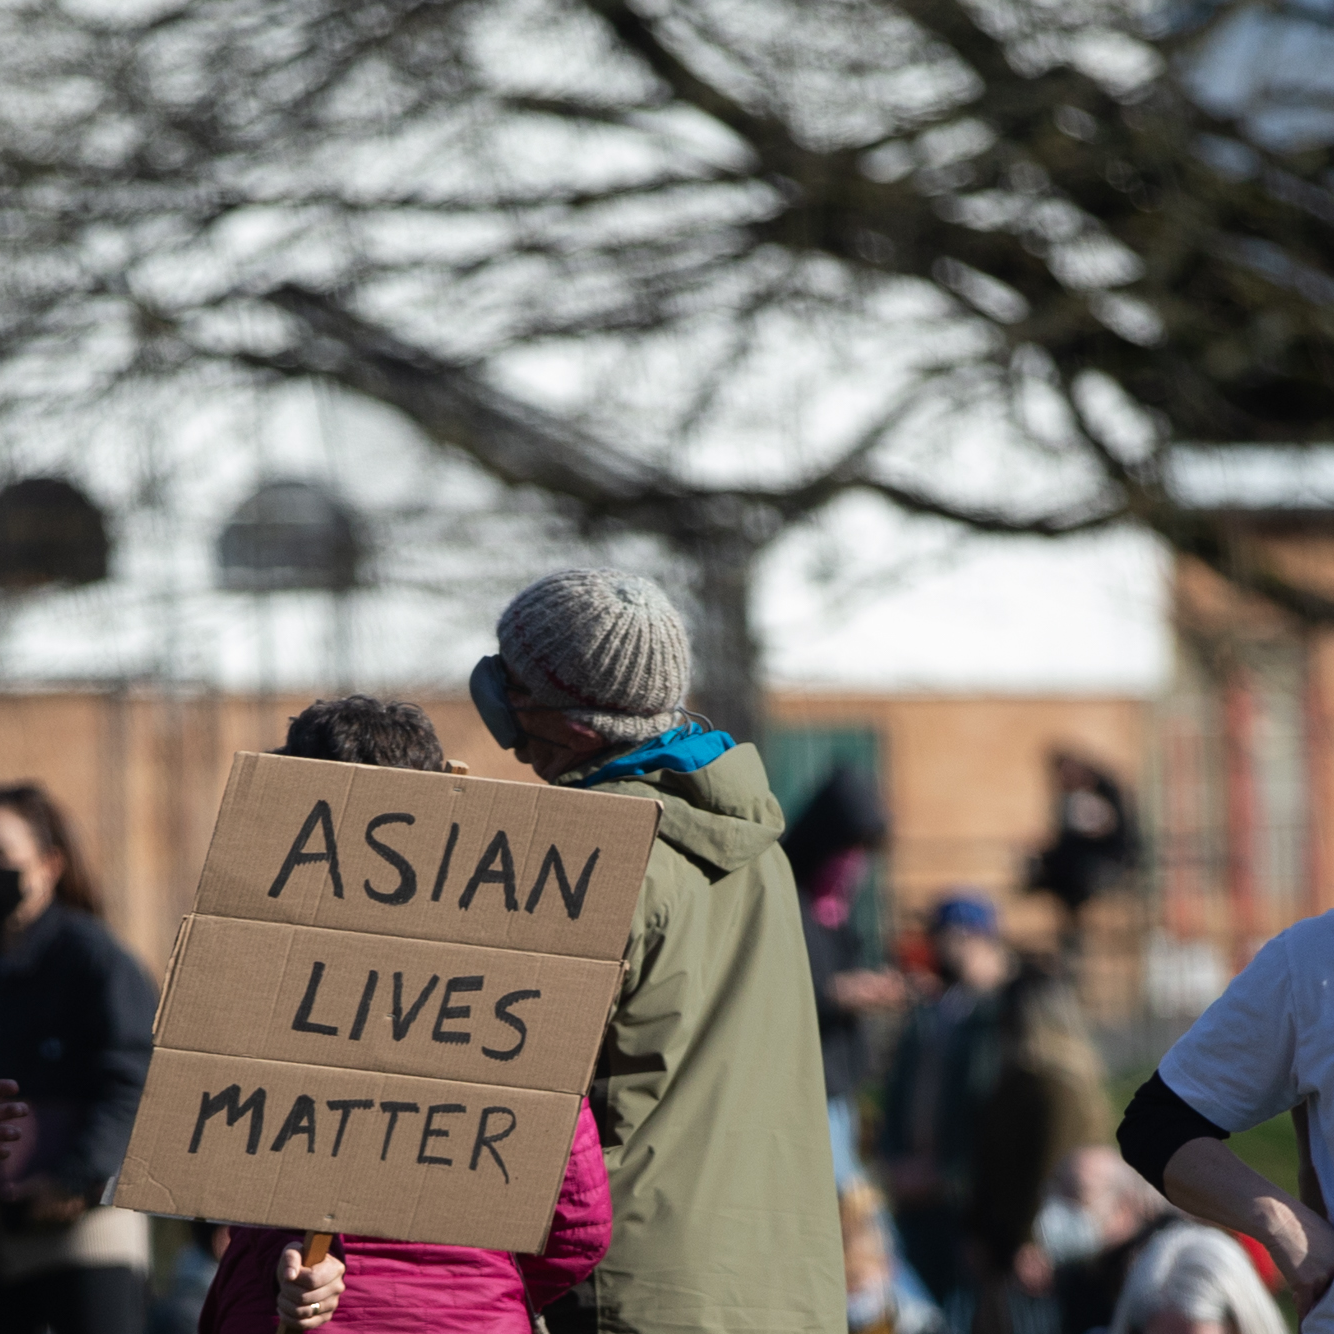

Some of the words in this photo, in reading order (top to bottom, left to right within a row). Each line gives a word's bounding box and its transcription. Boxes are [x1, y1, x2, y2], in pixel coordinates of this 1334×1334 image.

[267, 799, 602, 921] ASIAN
[291, 961, 542, 1062] LIVES
[186, 1084, 518, 1185] MATTER
